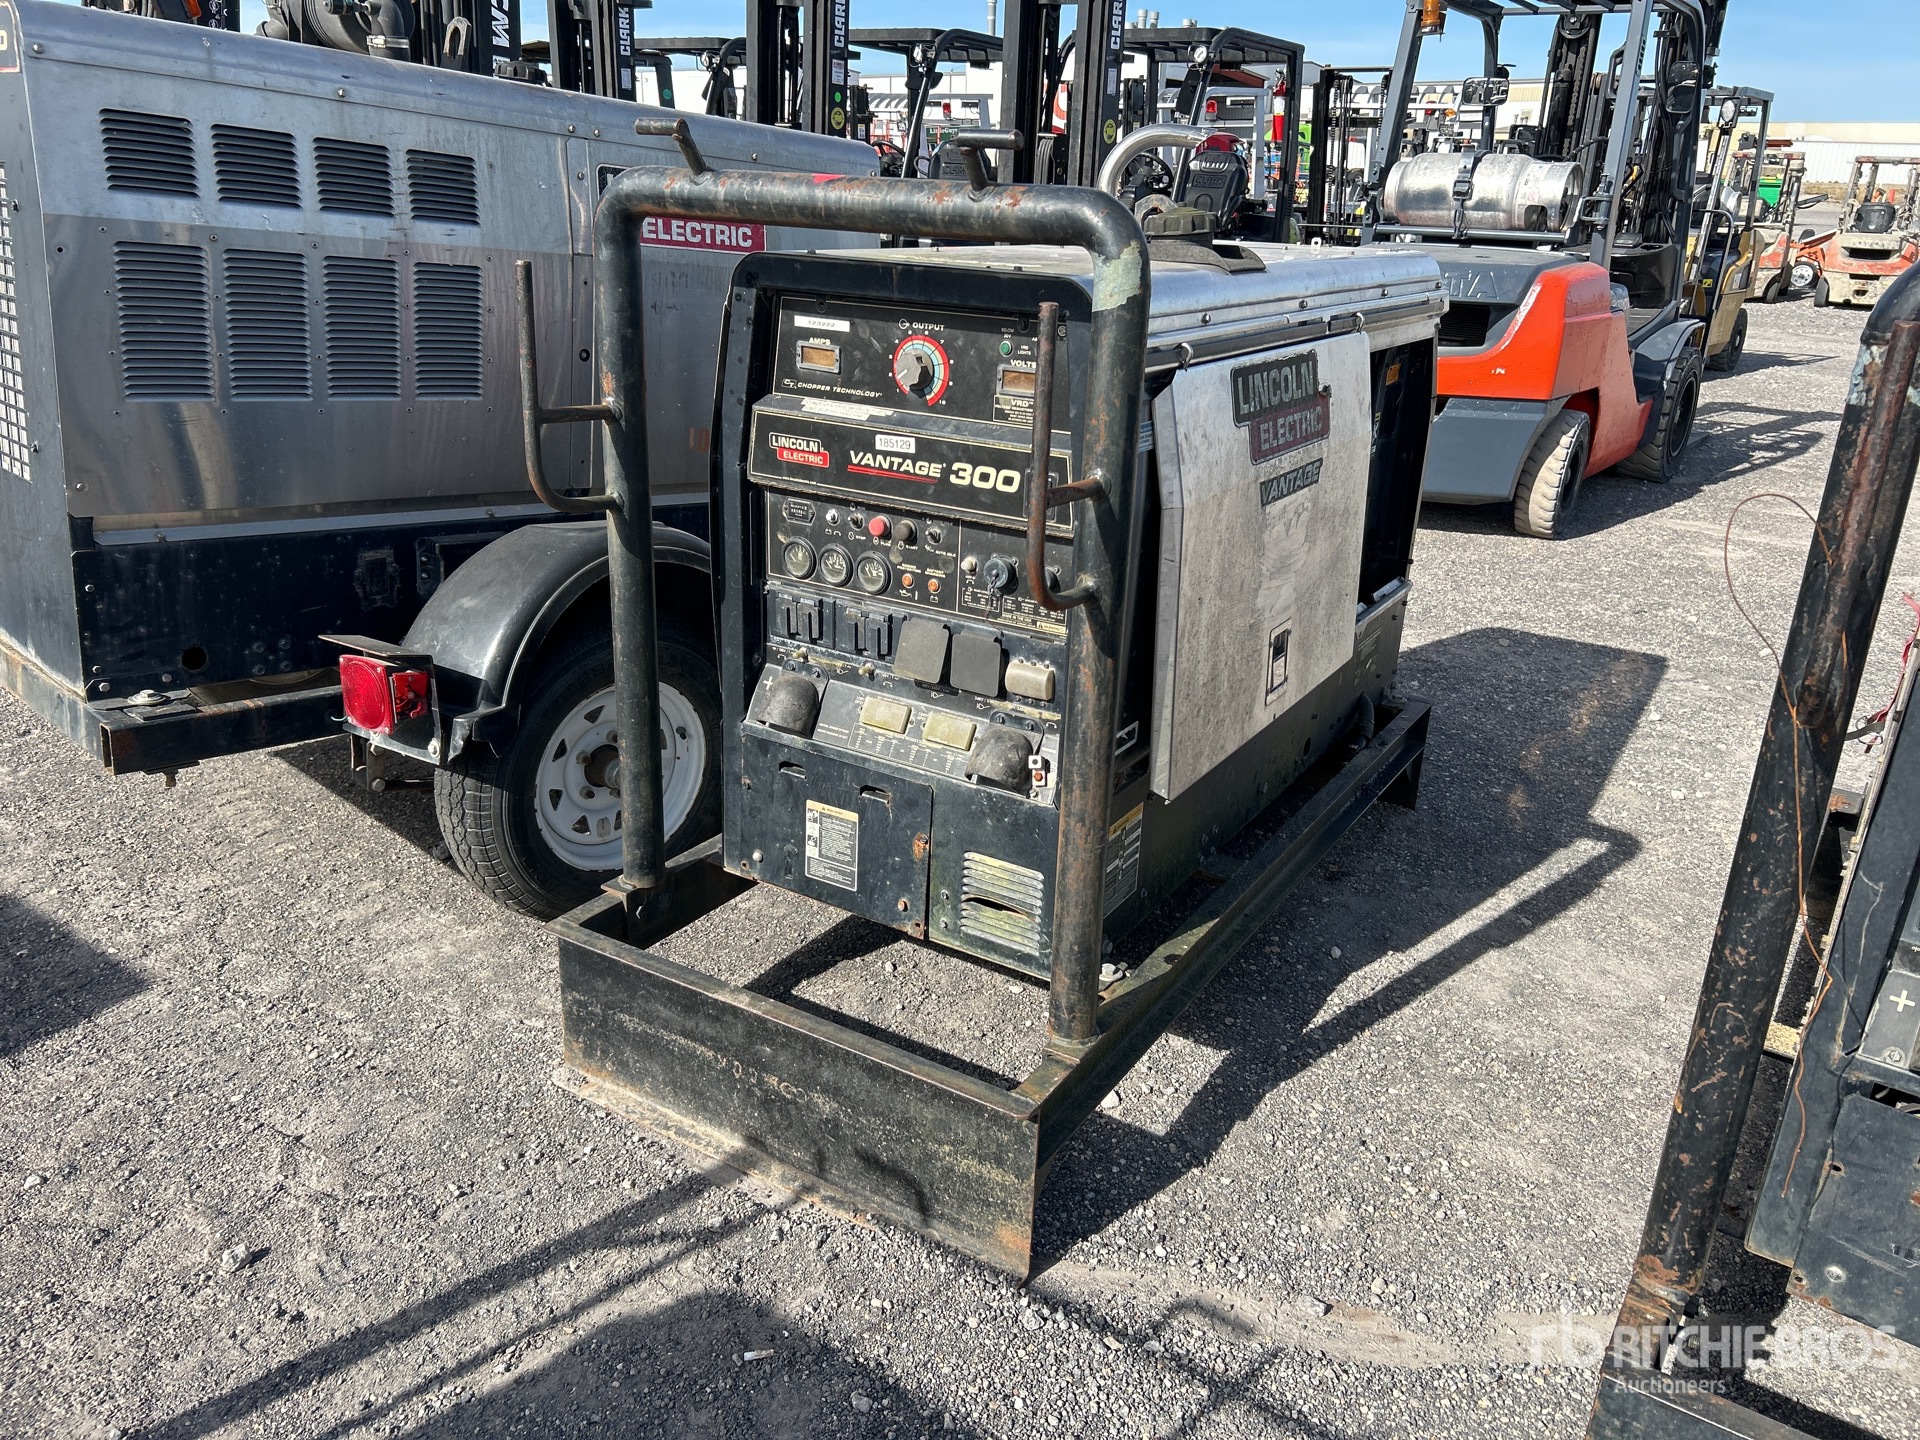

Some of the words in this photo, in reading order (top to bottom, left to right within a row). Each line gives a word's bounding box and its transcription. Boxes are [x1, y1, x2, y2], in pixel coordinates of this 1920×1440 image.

[617, 7, 631, 56] CLARK
[1110, 0, 1124, 50] CLAR
[642, 217, 752, 248] ELECTRIC
[912, 322, 945, 331] OUTPUT
[808, 337, 831, 346] AMPS
[1010, 360, 1037, 368] VOLTS
[797, 382, 830, 391] CHOPPER
[832, 387, 880, 397] TECHNOLOGY
[1237, 361, 1314, 415] LINCOLN
[1259, 406, 1322, 451] ELECTRIC
[771, 435, 818, 453] LINCOLN
[879, 437, 911, 450] 185129
[783, 451, 824, 465] ELECTRIC
[949, 462, 1021, 493] 300
[1261, 461, 1322, 506] VANTAGE
